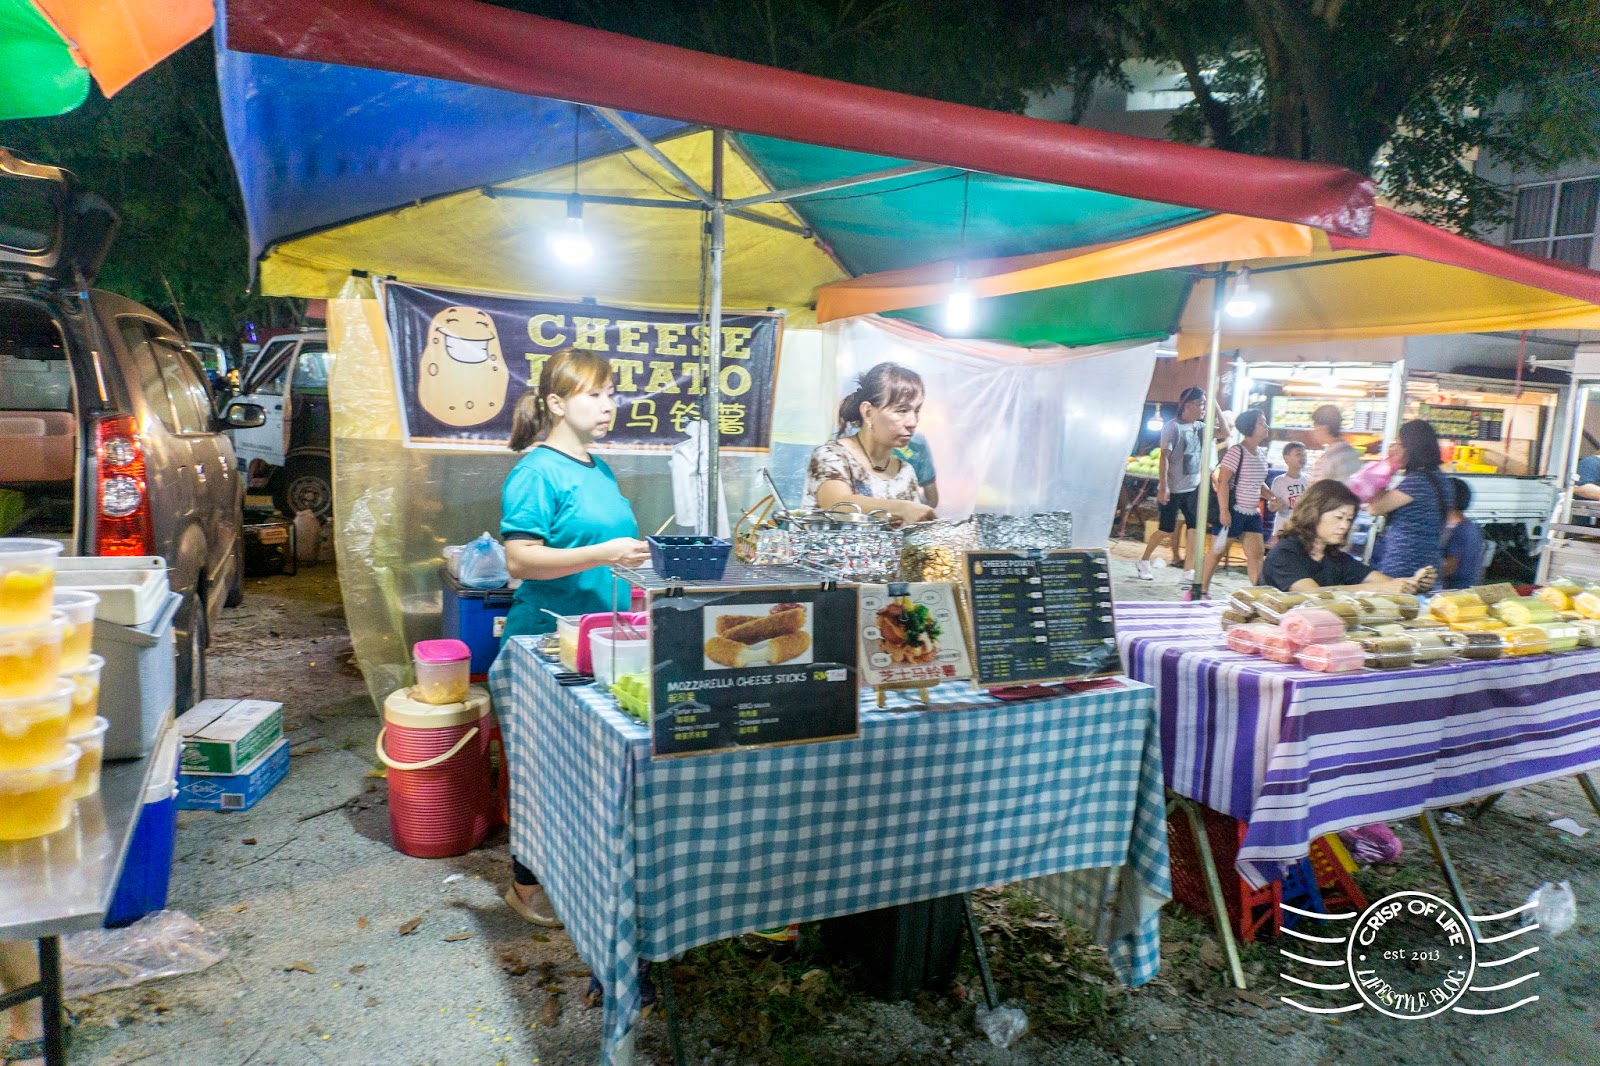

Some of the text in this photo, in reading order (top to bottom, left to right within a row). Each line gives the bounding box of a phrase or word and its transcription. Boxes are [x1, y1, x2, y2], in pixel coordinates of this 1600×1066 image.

[527, 313, 752, 359] CHEESE
[525, 352, 752, 397] PTATO
[667, 678, 735, 692] MOZZARELLA
[736, 674, 773, 687] CHEESE
[775, 672, 807, 684] STICKS
